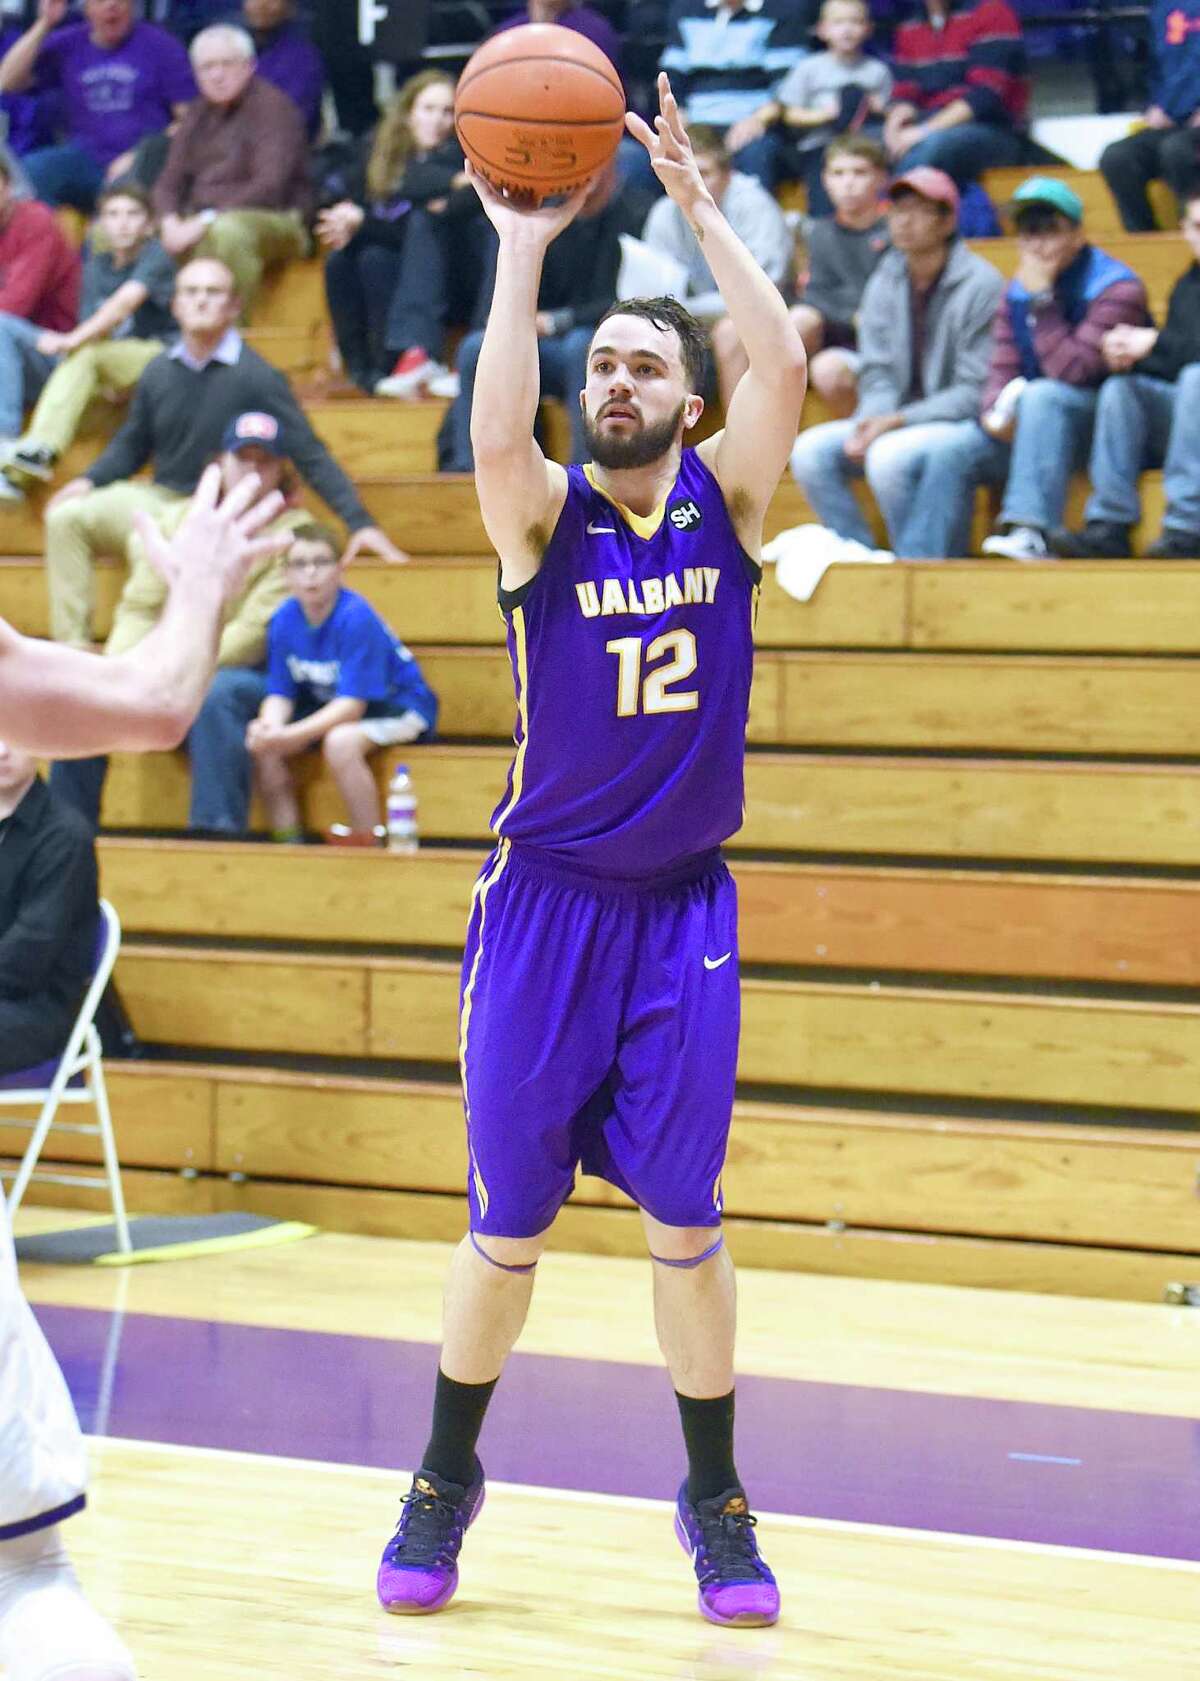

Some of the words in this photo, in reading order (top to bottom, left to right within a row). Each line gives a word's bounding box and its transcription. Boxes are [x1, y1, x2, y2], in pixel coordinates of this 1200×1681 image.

[670, 502, 701, 529] SH
[575, 567, 721, 619] UALBANY
[606, 628, 699, 717] 12
